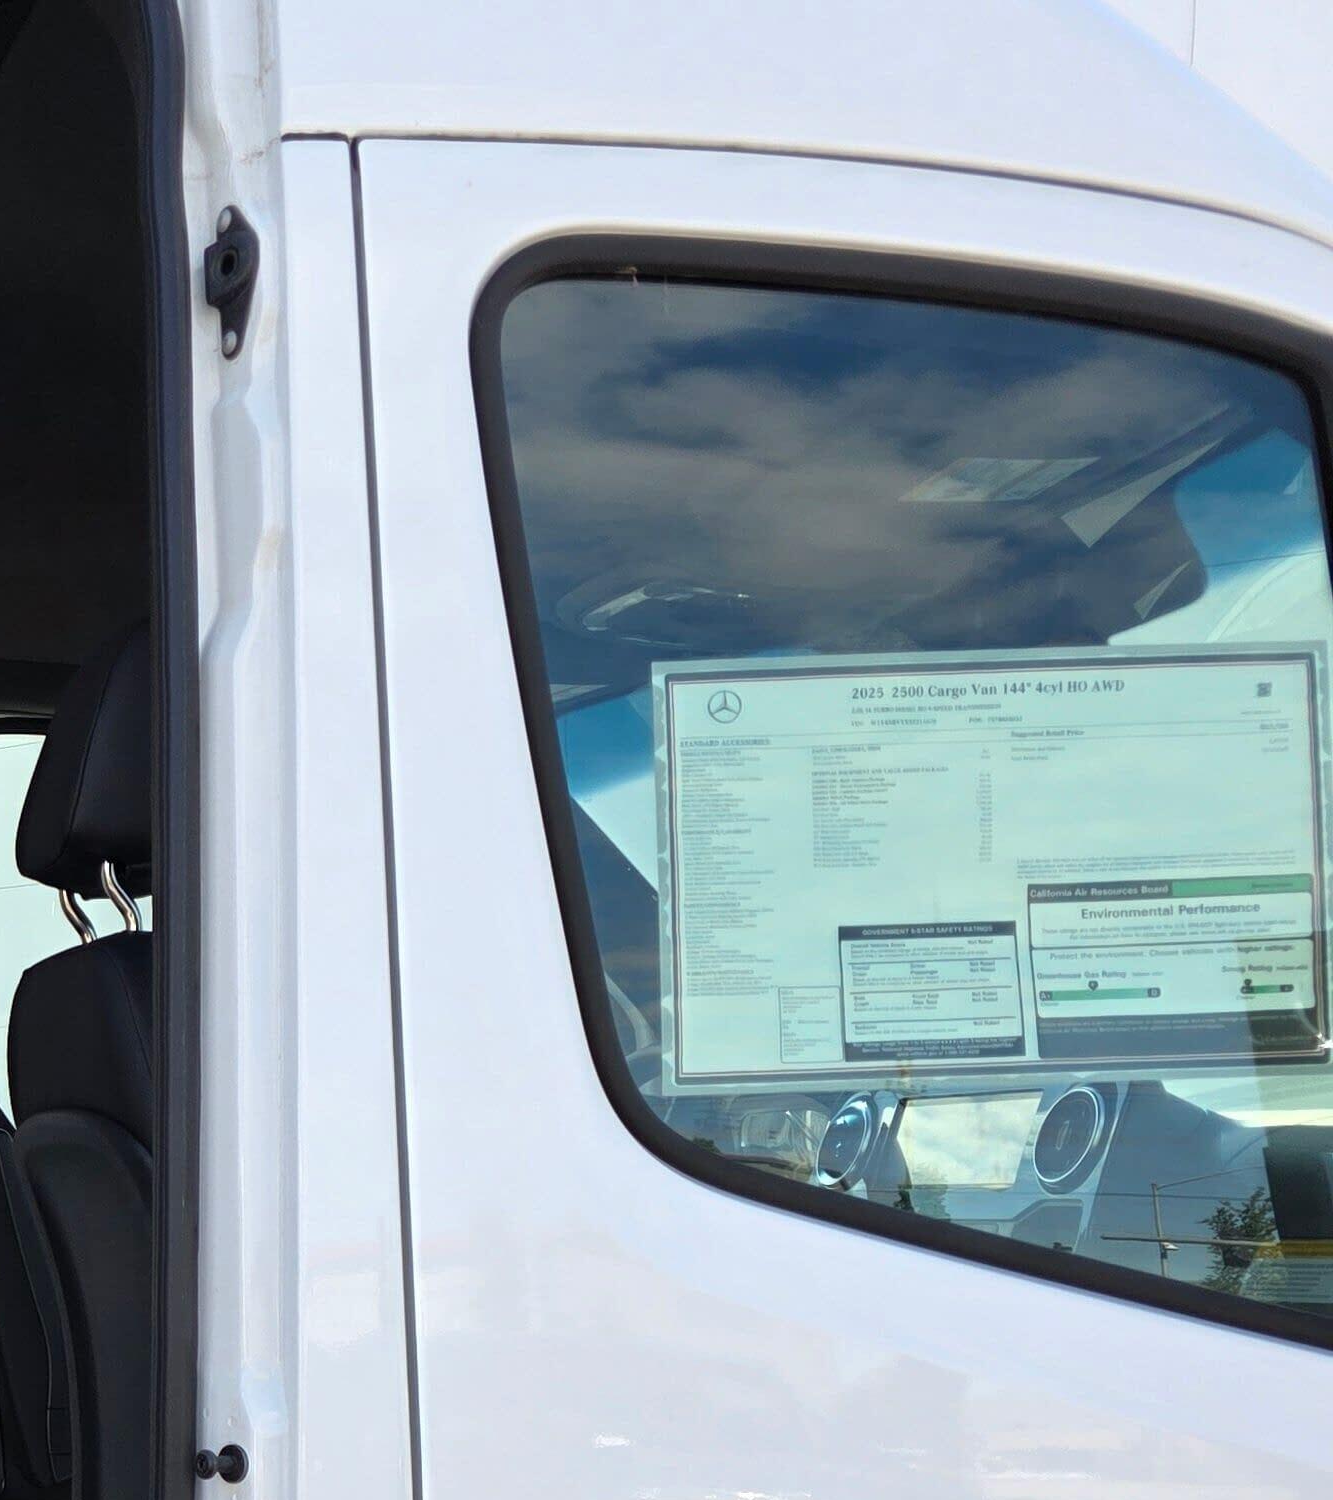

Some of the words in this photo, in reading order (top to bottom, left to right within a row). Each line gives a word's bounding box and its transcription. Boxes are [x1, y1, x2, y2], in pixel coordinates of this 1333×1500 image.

[852, 687, 884, 699] 2025
[892, 685, 924, 698] 2500
[928, 685, 967, 699] Cargo
[972, 684, 998, 696] Van
[1035, 681, 1063, 695] 4cyl
[1067, 681, 1088, 693] HO
[1091, 679, 1125, 692] AWD
[1030, 889, 1072, 898] California
[1075, 888, 1087, 897] Air
[1090, 887, 1138, 897] Resources
[1141, 885, 1169, 894] Board
[1081, 905, 1173, 919] Environmental
[1178, 903, 1261, 916] Performance
[862, 928, 909, 936] GOVERNMENT
[936, 926, 962, 934] SAFETY
